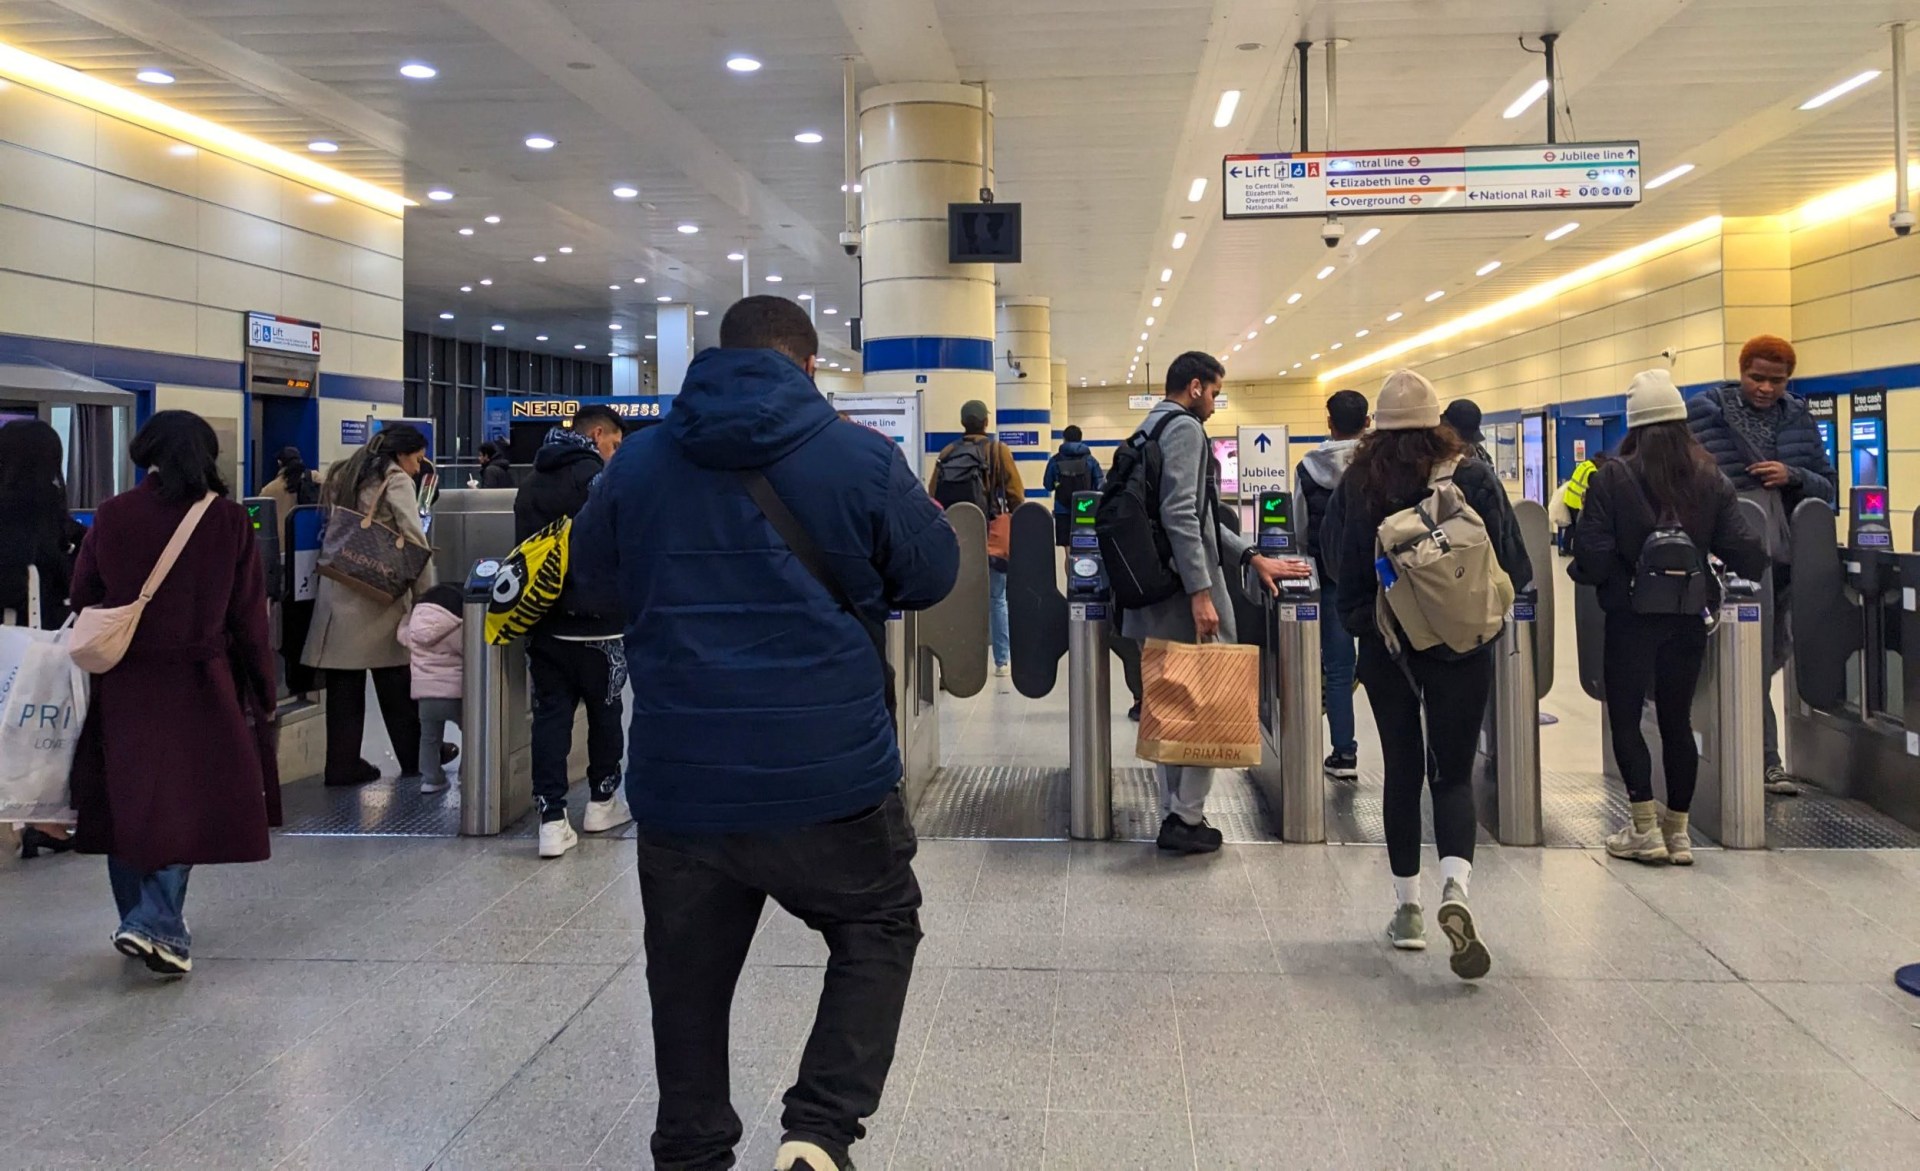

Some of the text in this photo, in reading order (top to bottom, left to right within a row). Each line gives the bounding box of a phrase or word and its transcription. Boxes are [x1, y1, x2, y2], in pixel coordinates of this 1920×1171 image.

[1560, 150, 1624, 161] Jubilee line
[1384, 157, 1404, 167] line
[1245, 166, 1270, 178] Lift
[1341, 177, 1415, 188] Elizabeth line
[1480, 188, 1551, 200] National Rail
[1341, 196, 1405, 207] Overground
[272, 327, 283, 336] Lift
[1854, 392, 1881, 404] free cash
[512, 401, 660, 416] NERO PRESS
[879, 419, 896, 427] line
[1242, 467, 1285, 477] Jubilee
[1243, 483, 1267, 492] Line
[1183, 747, 1241, 760] PRIMARK
